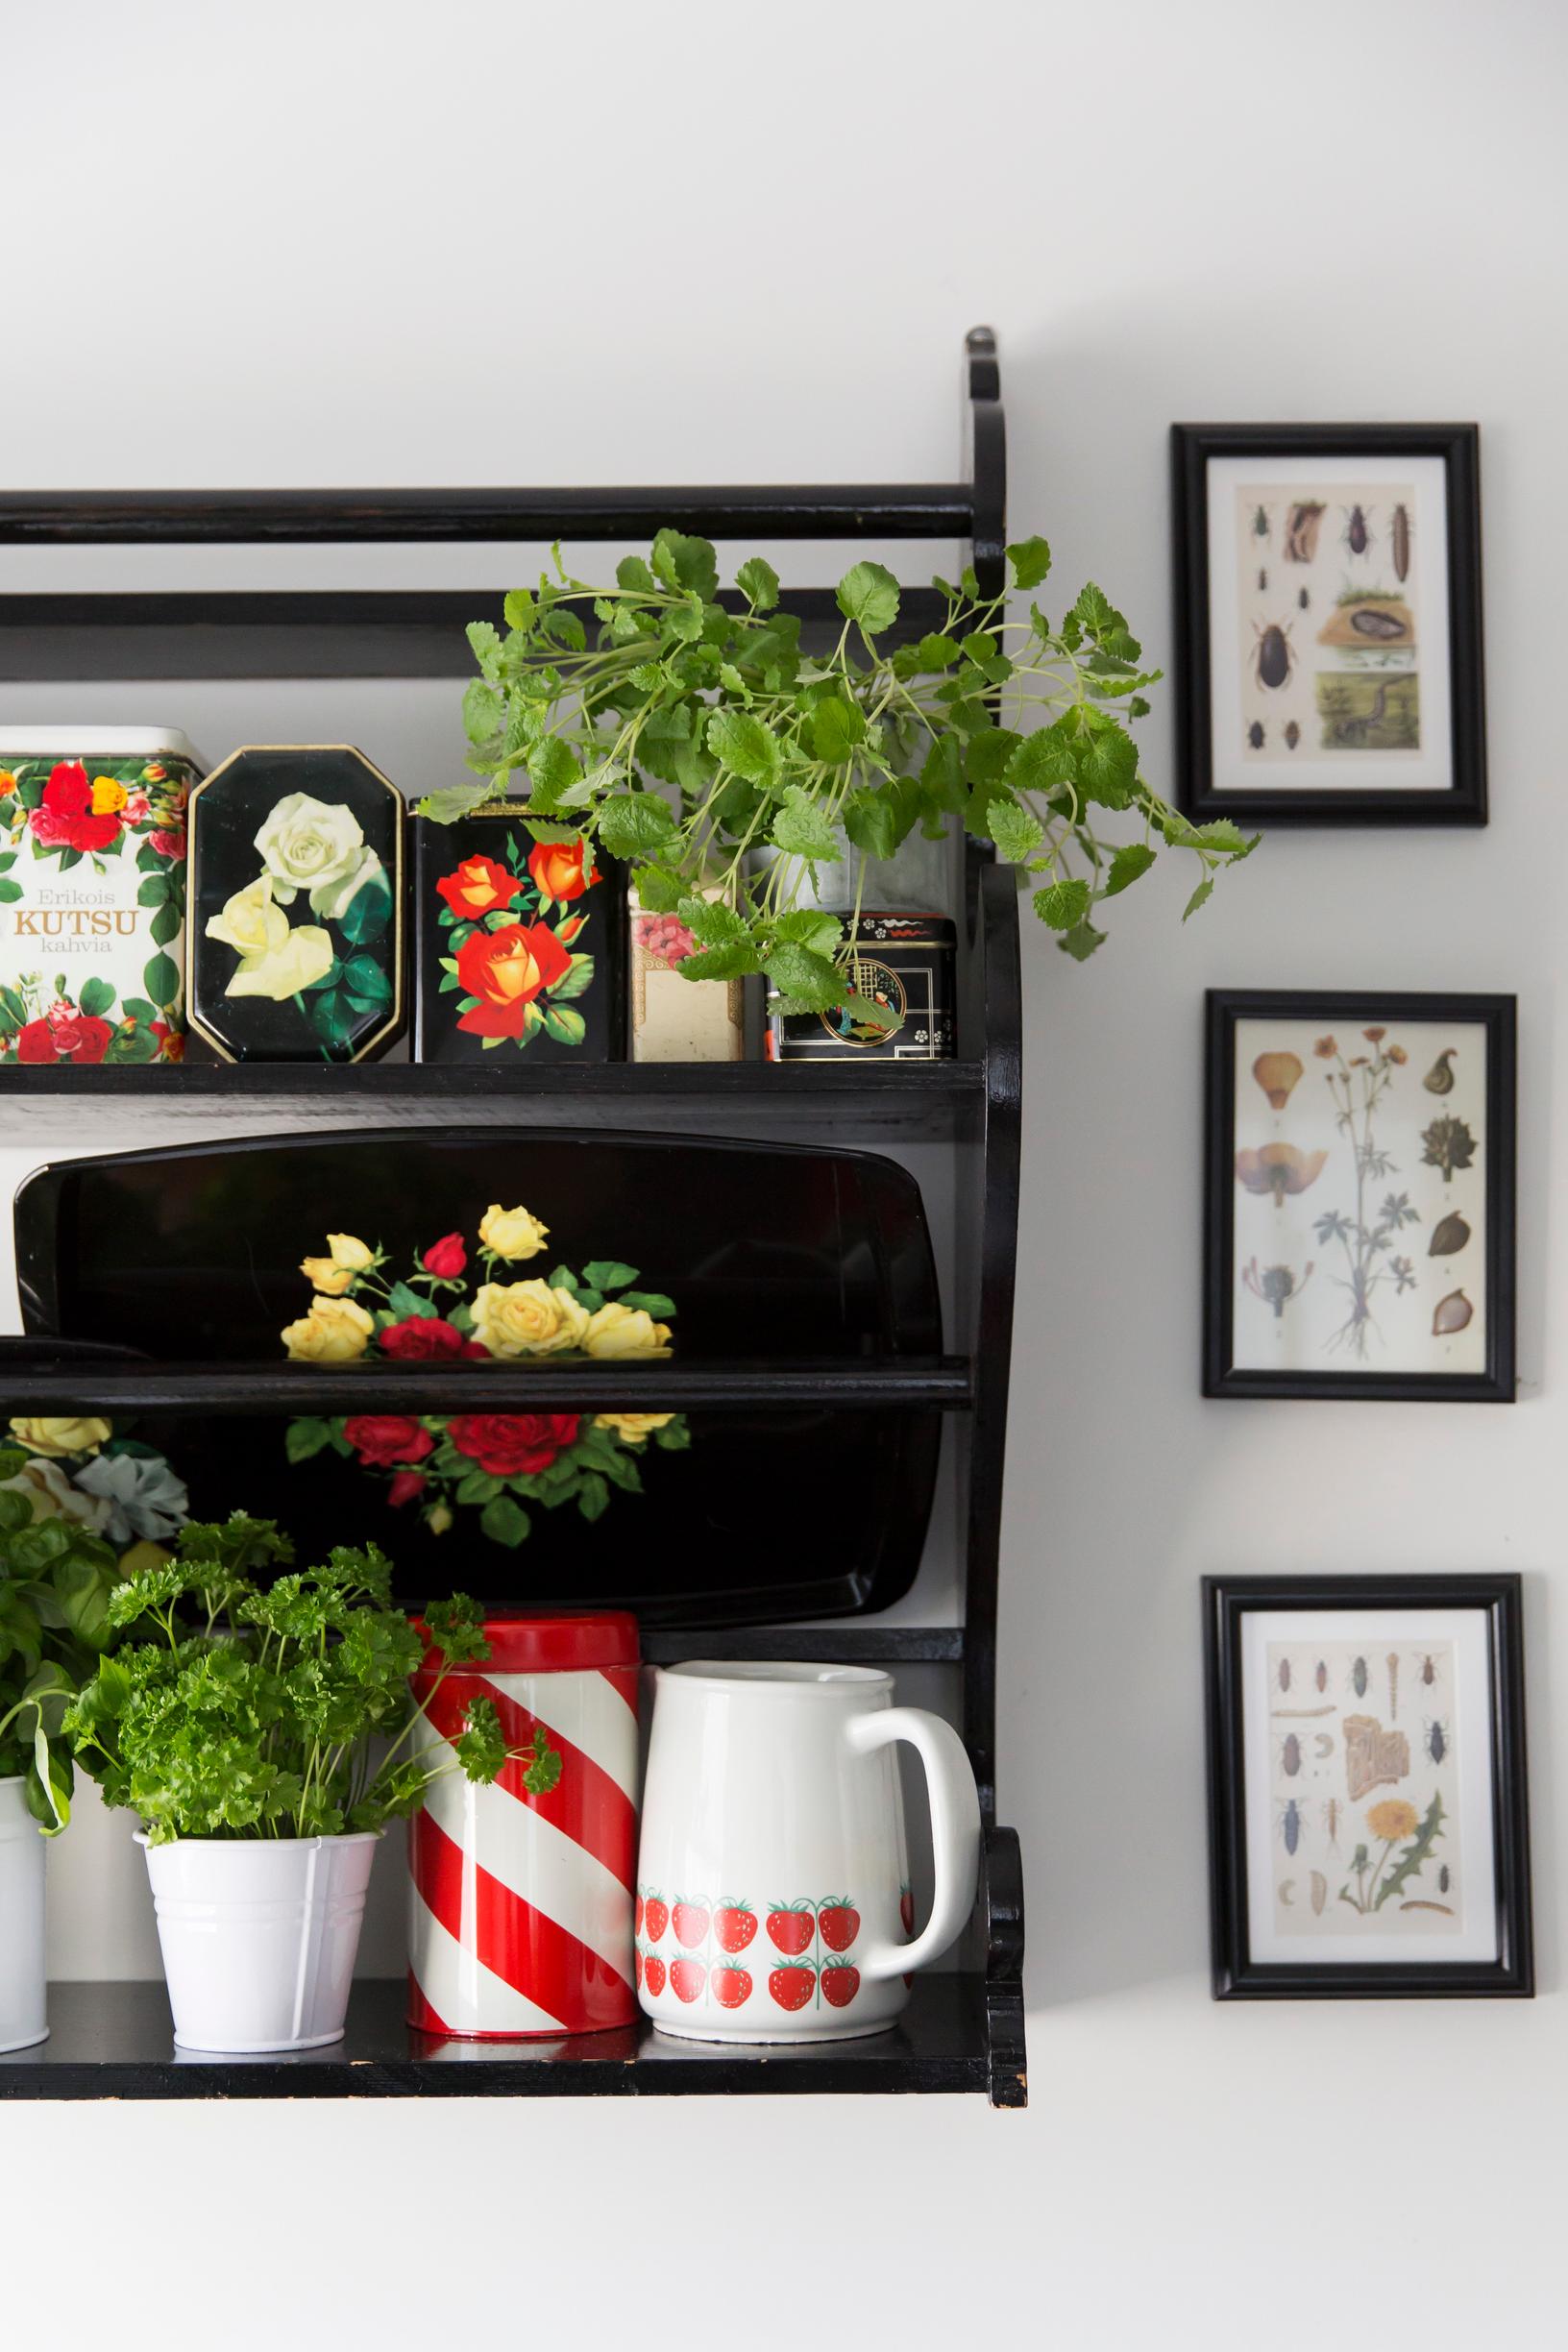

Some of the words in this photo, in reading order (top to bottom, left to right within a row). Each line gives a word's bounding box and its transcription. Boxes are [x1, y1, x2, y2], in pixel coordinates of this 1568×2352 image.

[37, 888, 115, 905] Erikois
[13, 911, 140, 935] KUTSU
[39, 937, 112, 953] kahvia
